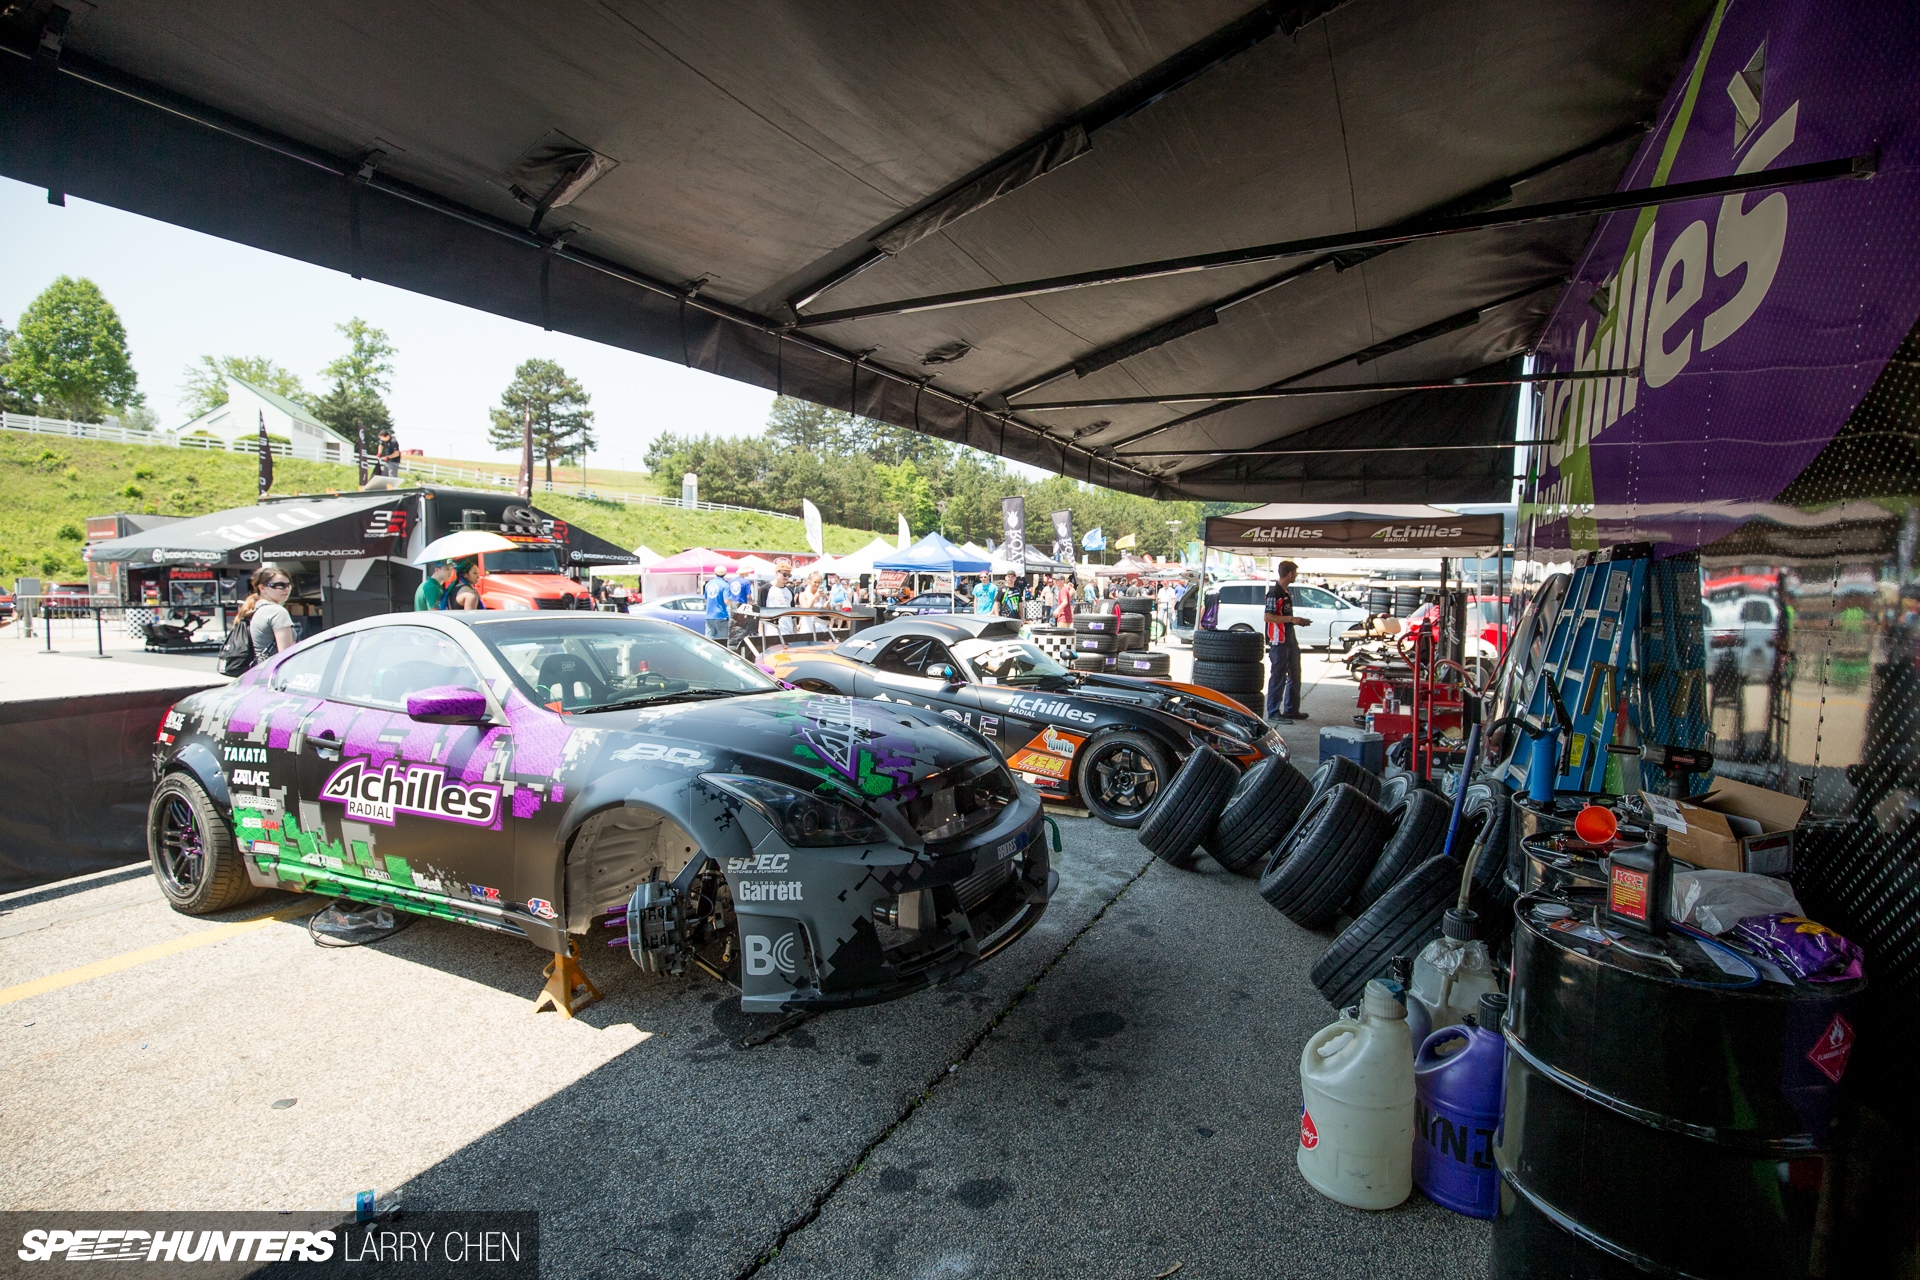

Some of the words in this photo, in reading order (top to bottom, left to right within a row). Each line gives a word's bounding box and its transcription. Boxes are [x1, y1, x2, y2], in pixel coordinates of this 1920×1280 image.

[1240, 526, 1323, 538] Achilles
[1371, 525, 1463, 538] Achilles
[263, 549, 365, 558] SCIONRACING.COM
[170, 571, 213, 579] POWER
[996, 694, 1098, 724] Achilles
[1008, 706, 1036, 719] RADIAL
[223, 746, 268, 763] TAKATA
[1020, 754, 1064, 772] AEM
[325, 763, 493, 820] Achilles
[349, 801, 392, 819] RADIAL
[727, 853, 790, 870] SPEC
[469, 883, 500, 901] NX
[739, 881, 804, 901] Garrett
[1415, 1098, 1496, 1170] NINJ
